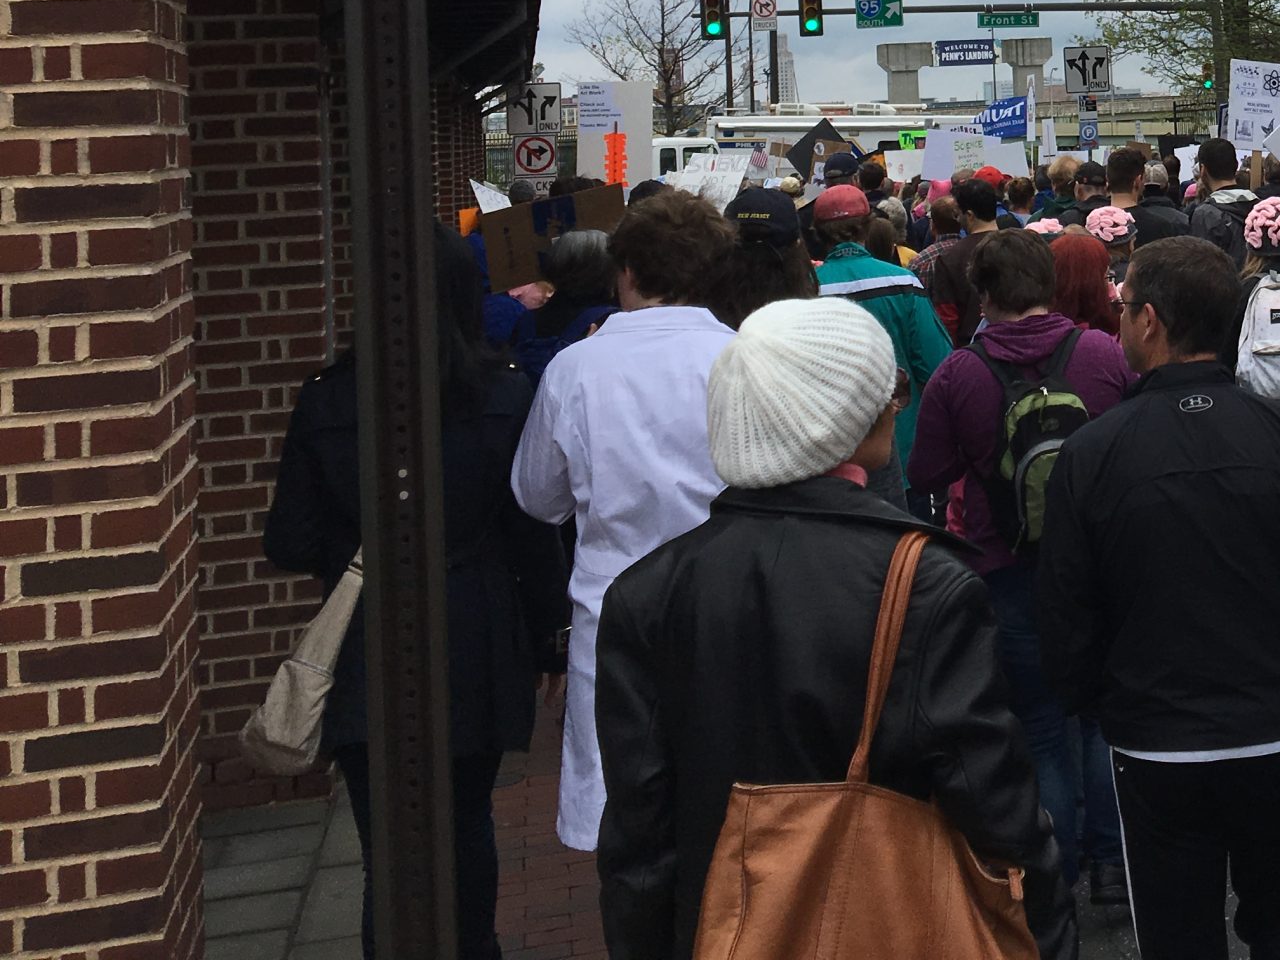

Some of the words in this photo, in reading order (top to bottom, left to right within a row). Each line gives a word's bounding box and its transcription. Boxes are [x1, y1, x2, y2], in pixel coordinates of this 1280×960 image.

[860, 1, 879, 14] 95
[859, 19, 885, 28] SOUTH
[983, 15, 1015, 25] Front
[1021, 15, 1033, 24] St
[944, 43, 978, 51] WELCOME
[941, 51, 965, 61] PENN'S
[965, 50, 994, 60] LANDING
[1090, 81, 1108, 89] ONLY
[538, 122, 560, 131] ONLY
